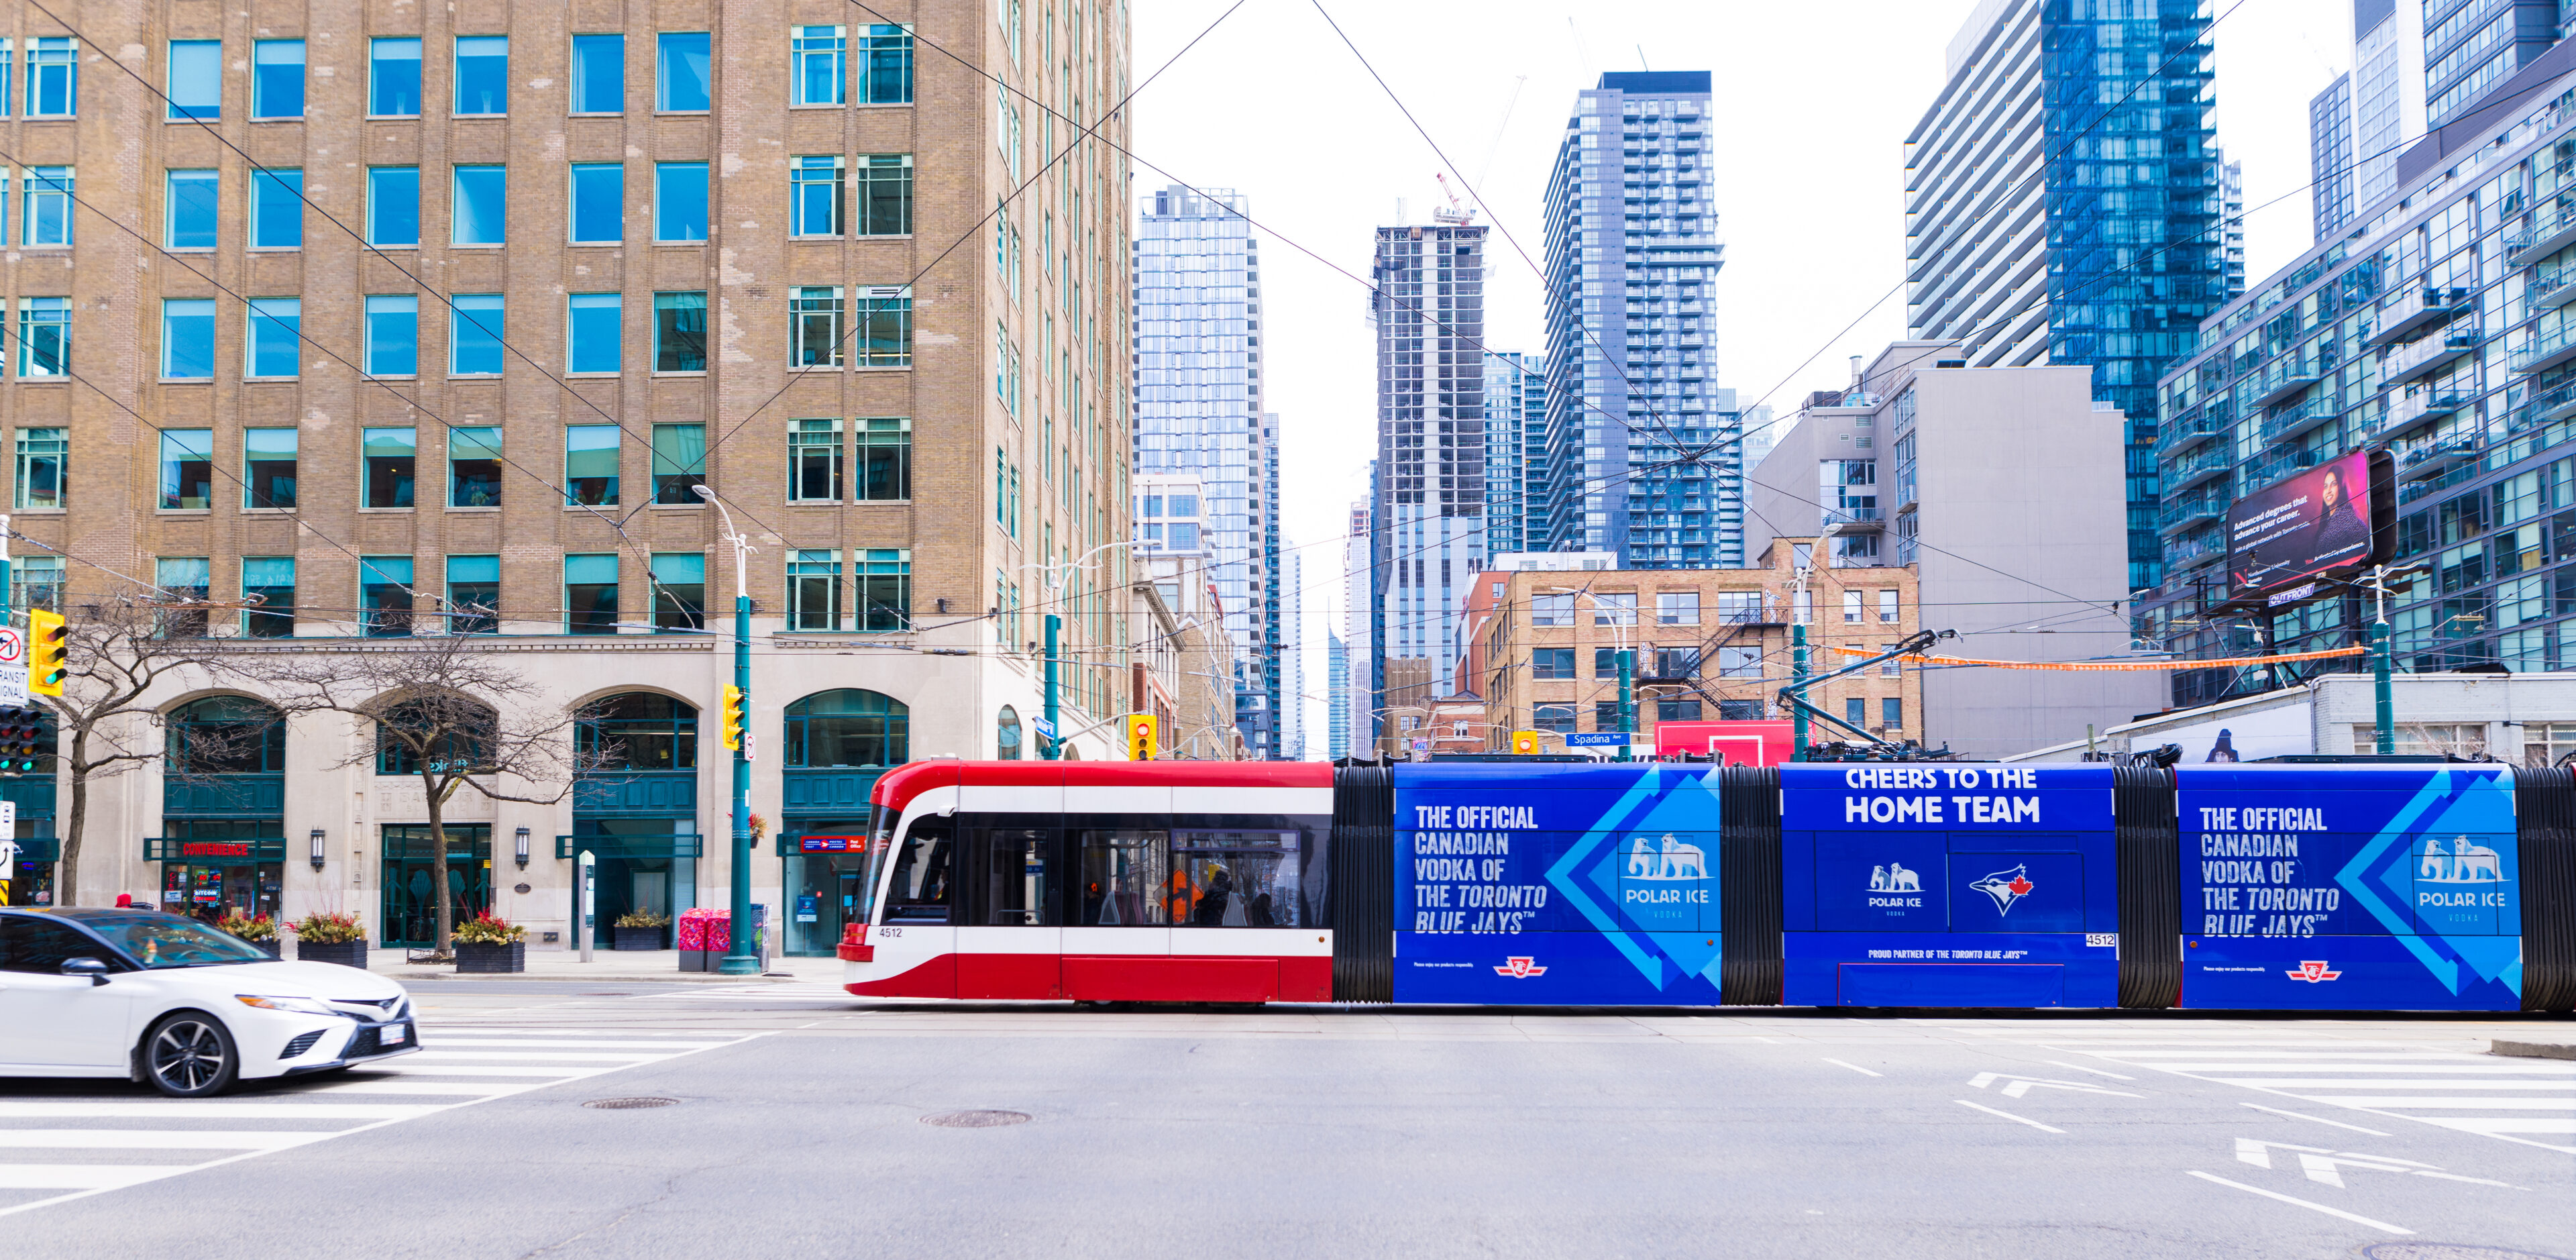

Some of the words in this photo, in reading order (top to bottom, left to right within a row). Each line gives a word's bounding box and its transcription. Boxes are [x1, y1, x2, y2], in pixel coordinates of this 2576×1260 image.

[2234, 511, 2265, 531] Advanced
[2265, 502, 2292, 517] degrees
[2292, 495, 2308, 507] that
[2234, 525, 2260, 541] advance
[2260, 519, 2276, 532] your
[2276, 510, 2300, 524] career.
[2245, 540, 2257, 550] global
[2257, 535, 2273, 545] network
[2273, 530, 2282, 538] with
[2270, 584, 2313, 605] OUTFRONT
[1574, 735, 1610, 745] Spadina
[1846, 769, 1937, 788] CHEERS
[1943, 769, 1979, 788] TO
[1986, 769, 2037, 788] THE
[1415, 806, 1452, 828] THE
[1457, 806, 1538, 829] OFFICIAL
[1845, 796, 1943, 823] HOME
[1952, 796, 2039, 823] TEAM
[2200, 808, 2238, 830] THE
[2243, 808, 2327, 831] OFFICIAL
[183, 843, 248, 855] CONVENIENCE
[1415, 832, 1509, 855] CANADIAN
[2201, 834, 2298, 857] CANADIAN
[1415, 859, 1476, 881] VODKA
[1482, 859, 1505, 882] OF
[2202, 861, 2265, 884] VODKA
[2271, 861, 2295, 884] OF
[1415, 885, 1450, 907] THE
[1458, 886, 1547, 908] TORONTO
[1626, 890, 1680, 903] POLAR
[1686, 890, 1709, 903] ICE
[1869, 898, 1904, 906] POLAR
[1907, 898, 1922, 907] ICE
[2202, 888, 2240, 910] THE
[2247, 888, 2339, 911] TORONTO
[2420, 892, 2476, 906] POLAR
[2482, 893, 2506, 906] ICE
[1415, 911, 1466, 934] BLUE
[1654, 910, 1682, 918] VODKA
[2449, 914, 2478, 922] VODKA
[879, 928, 902, 937] 4512
[2204, 914, 2256, 937] BLUE
[2086, 935, 2114, 945] 4512
[1868, 950, 1892, 958] PROUD
[1893, 950, 1924, 959] PARTNER
[1926, 950, 1934, 959] OF
[1936, 950, 1949, 959] THE
[1951, 950, 1982, 959] TORONTO
[1984, 951, 2002, 959] BLUE
